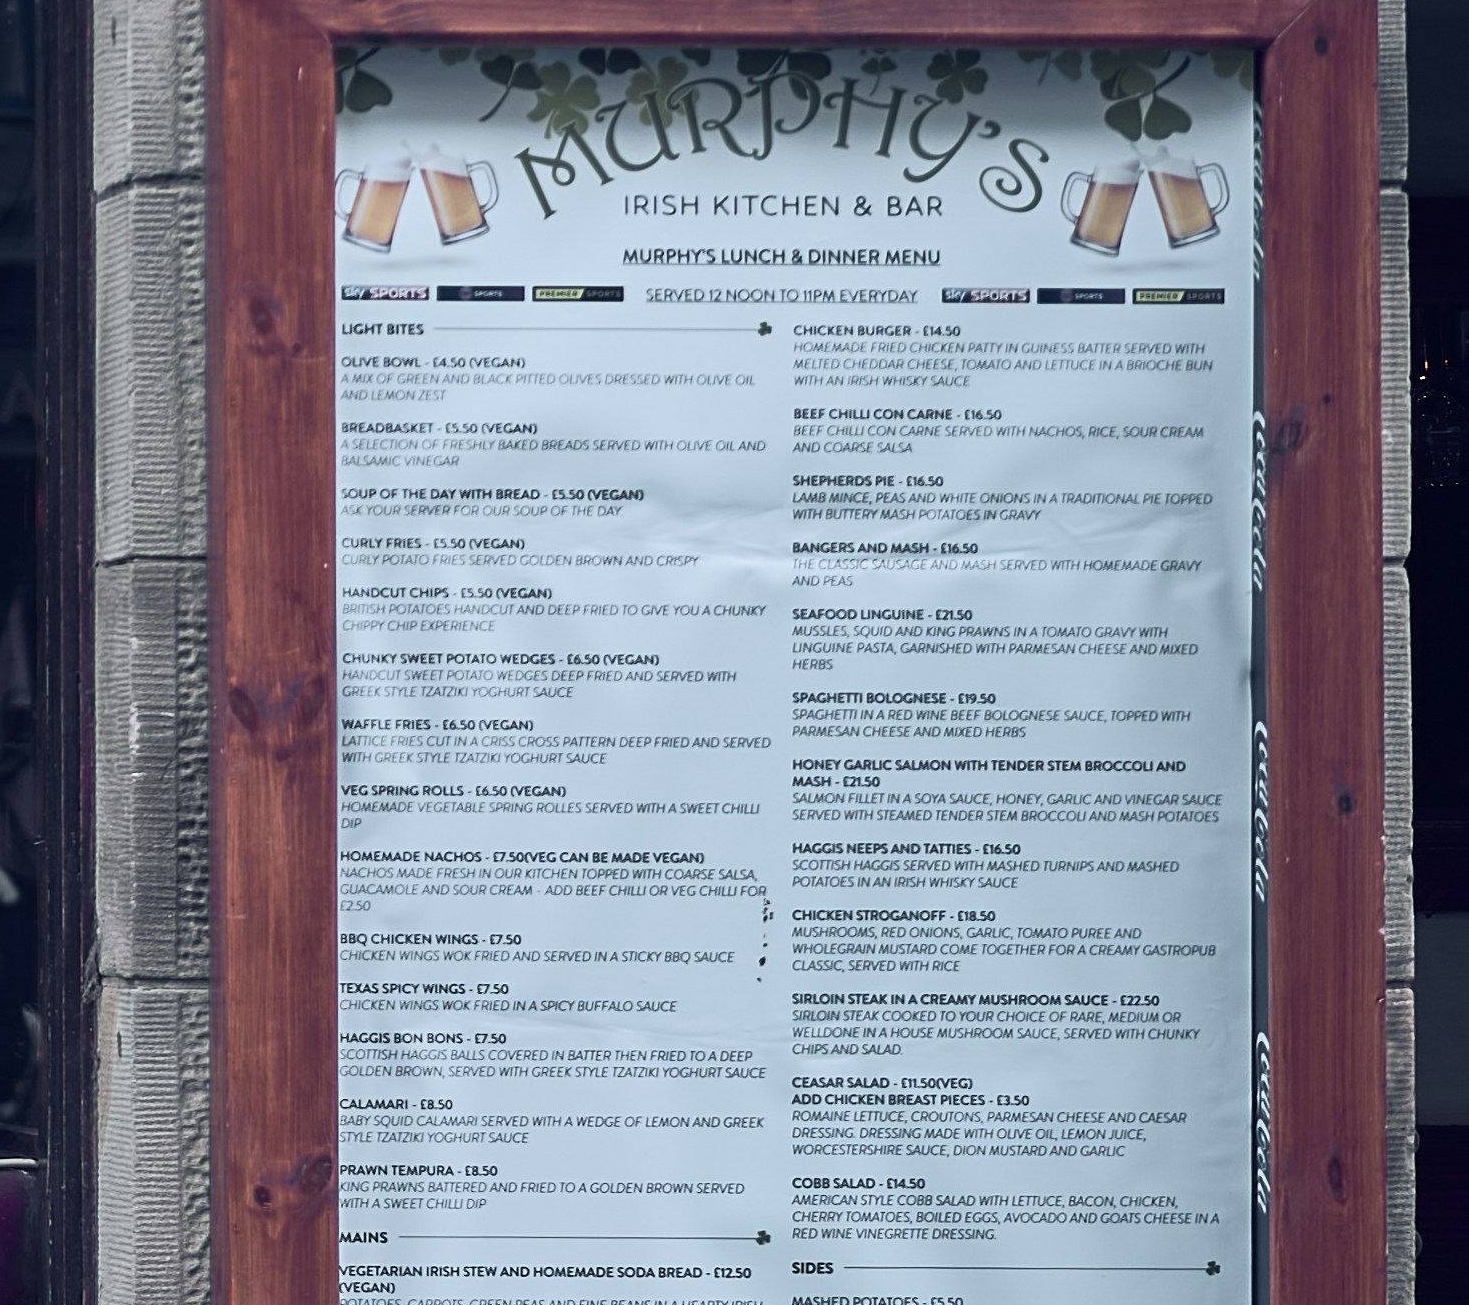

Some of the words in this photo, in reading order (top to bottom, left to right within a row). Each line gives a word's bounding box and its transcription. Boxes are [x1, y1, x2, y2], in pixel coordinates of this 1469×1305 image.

[513, 71, 1049, 219] MURPHY'S
[624, 194, 699, 216] IRISH
[713, 194, 840, 217] KITCHEN
[853, 194, 872, 217] &
[887, 195, 943, 217] BAR
[623, 249, 716, 265] MURPHY'S
[720, 249, 786, 265] LUNCH
[791, 249, 803, 265] &
[808, 249, 881, 265] DINNER
[885, 249, 941, 266] MENU
[344, 288, 365, 300] sky
[369, 288, 426, 298] SPORTS
[645, 287, 705, 303] SERVED
[709, 288, 723, 303] 12
[725, 288, 776, 303] NOON
[780, 288, 800, 303] TO
[803, 288, 836, 303] 11PM
[839, 288, 919, 303] EVERYDAY
[946, 290, 966, 302] sky
[971, 290, 1026, 301] SPORTS
[341, 322, 383, 336] LIGHT
[386, 323, 425, 336] BITES
[793, 324, 854, 337] CHICKEN
[857, 324, 912, 337] BURGER
[922, 325, 962, 337] £14.50
[340, 355, 380, 368] OLIVE
[382, 356, 422, 368] BOWL
[432, 356, 466, 369] £4.50
[469, 356, 526, 369] (VEGAN)
[793, 374, 824, 386] WITH
[846, 374, 879, 387] IRISH
[881, 374, 929, 387] WHISKY
[929, 374, 971, 388] SAUCE
[793, 407, 826, 420] BEEF
[828, 408, 871, 420] CHILLI
[873, 408, 905, 421] CON
[906, 408, 953, 421] CARNE
[964, 408, 1003, 421] £16.50
[340, 718, 391, 731] WAFFLE
[395, 718, 432, 731] FRIES
[442, 718, 476, 731] £6.50
[478, 719, 534, 732] (VEGAN)
[791, 909, 854, 922] CHICKEN
[855, 909, 947, 922] STROGANOFF
[957, 910, 997, 922] £18.50
[790, 959, 845, 974] CLASSIC,
[847, 959, 897, 972] SERVED
[898, 959, 930, 972] WITH
[930, 959, 962, 973] RICE
[339, 1231, 389, 1244] MAINS
[791, 1261, 835, 1275] SIDES
